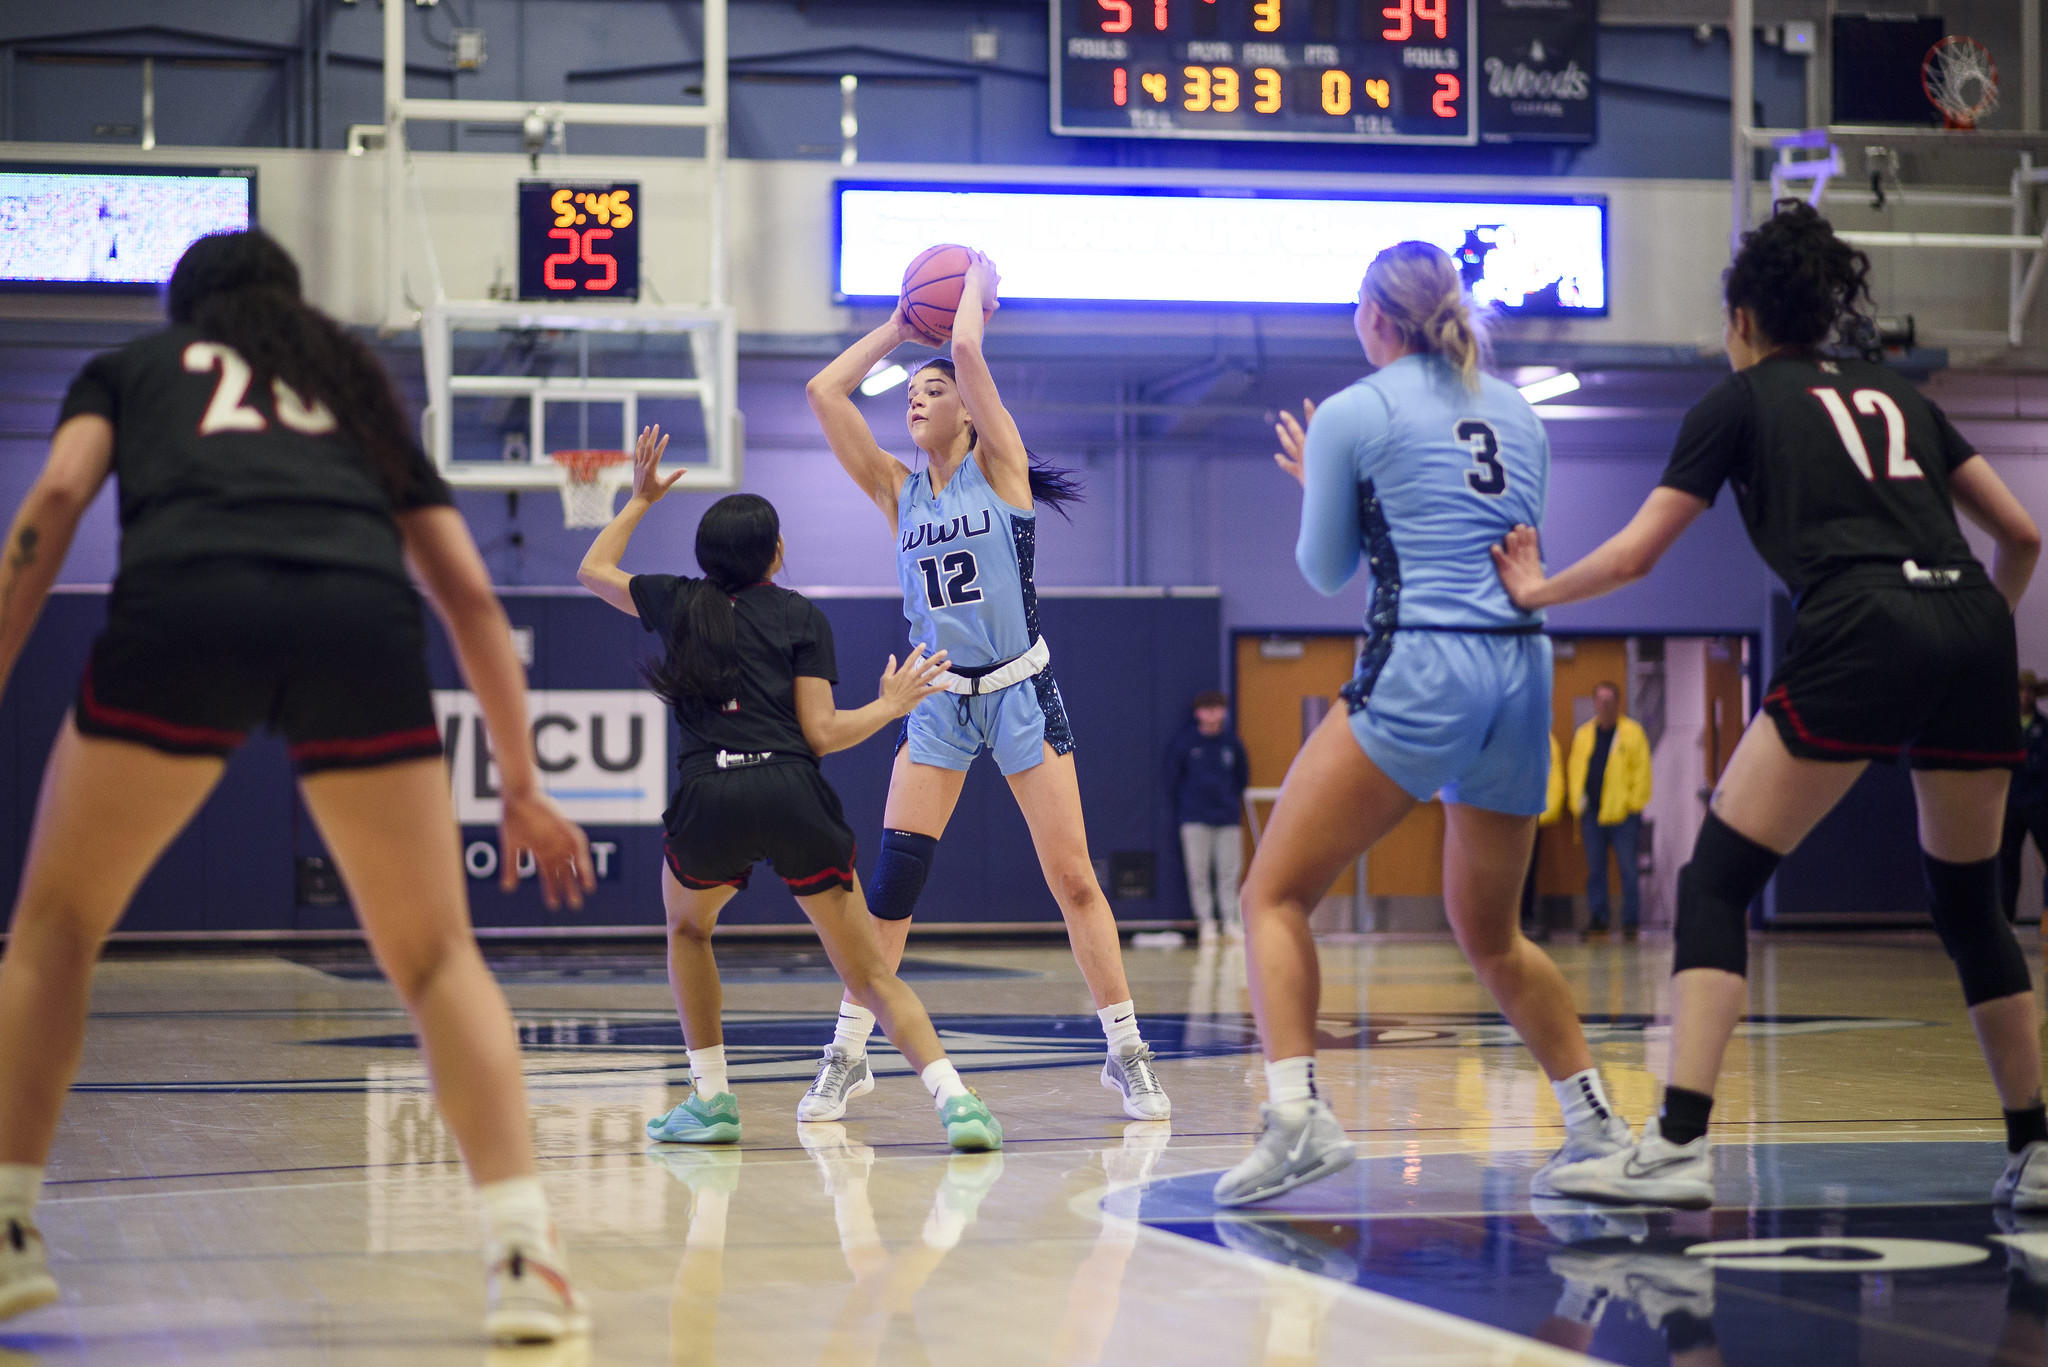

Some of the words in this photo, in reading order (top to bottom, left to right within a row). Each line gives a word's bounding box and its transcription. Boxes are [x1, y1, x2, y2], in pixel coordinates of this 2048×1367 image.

[1382, 0, 1448, 41] 34
[1068, 38, 1128, 60] FOULS
[1403, 48, 1460, 70] FOULS
[1113, 67, 1127, 106] 1
[1184, 66, 1240, 112] 33
[1254, 68, 1282, 114] 3
[1321, 70, 1351, 116] 0
[1432, 73, 1460, 118] 2
[1484, 56, 1590, 100] Woods
[551, 189, 633, 229] 5:45
[543, 228, 618, 291] 25
[1806, 386, 1926, 481] 12
[1453, 417, 1508, 500] 3
[901, 508, 991, 553] WWU
[916, 548, 985, 611] 12
